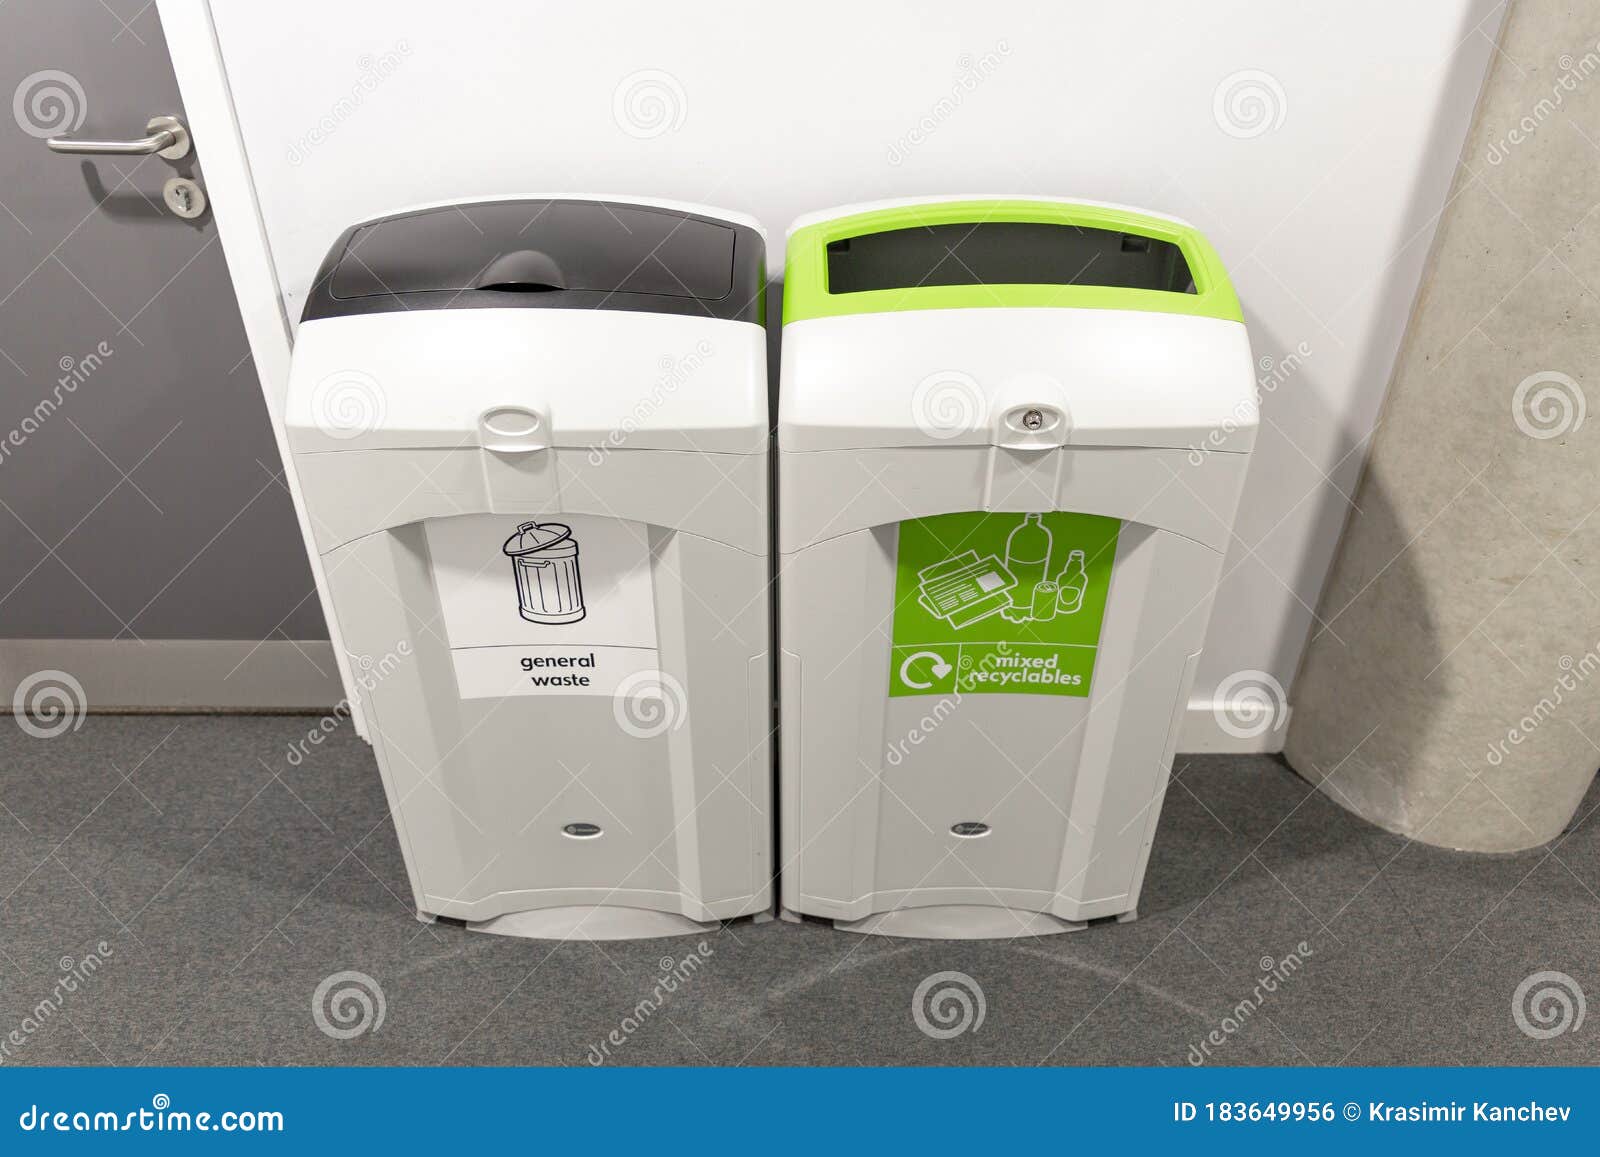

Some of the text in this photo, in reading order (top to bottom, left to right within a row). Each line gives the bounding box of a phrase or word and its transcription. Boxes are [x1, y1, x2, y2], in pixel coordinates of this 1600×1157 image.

[520, 653, 596, 671] general
[995, 653, 1059, 669] mixed
[531, 674, 590, 686] waste
[968, 668, 1082, 686] recyclables
